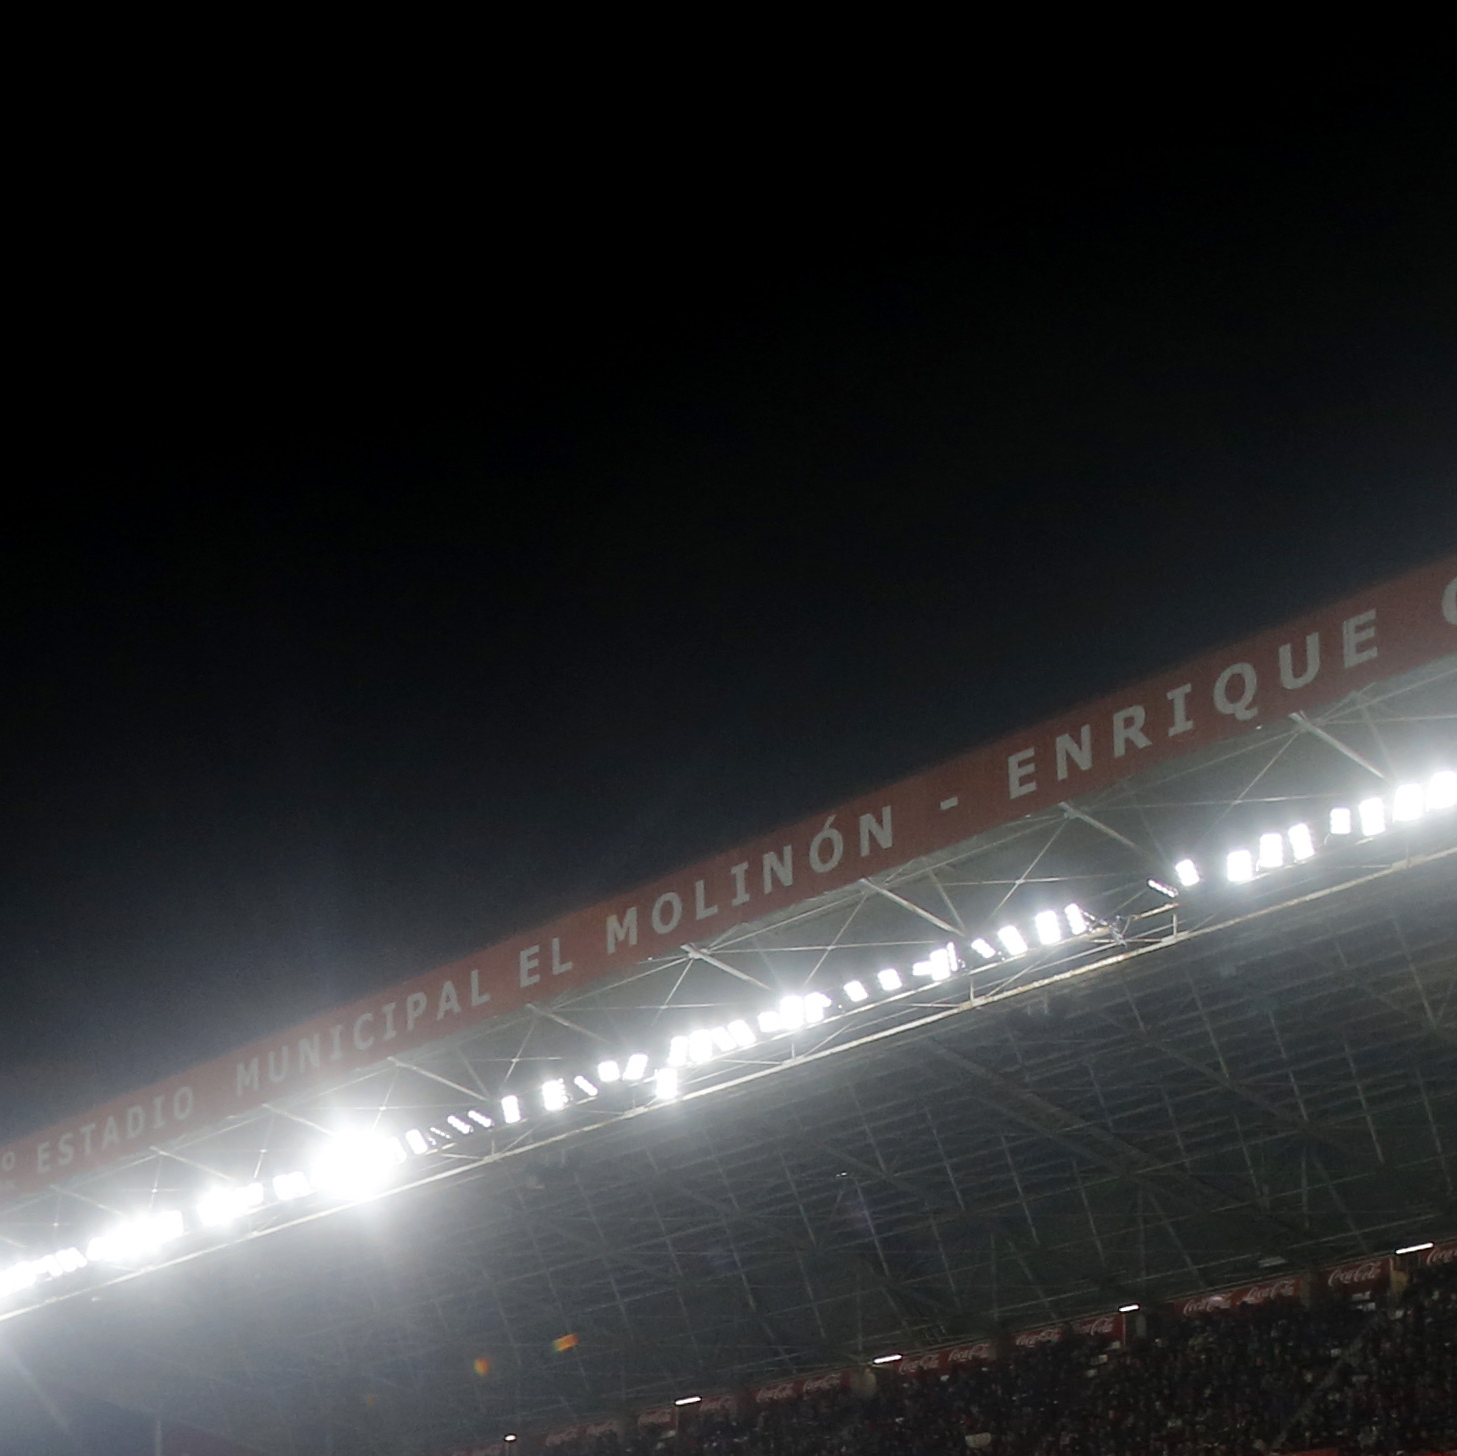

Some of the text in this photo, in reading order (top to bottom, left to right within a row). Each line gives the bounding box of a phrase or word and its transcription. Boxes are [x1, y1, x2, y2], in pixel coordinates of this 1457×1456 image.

[37, 1086, 193, 1174] ESTADIO
[237, 969, 491, 1097] MUNICIPAL
[519, 938, 573, 989] EL
[606, 805, 893, 956] MOLINÓN
[1007, 609, 1379, 800] ENRIQUE
